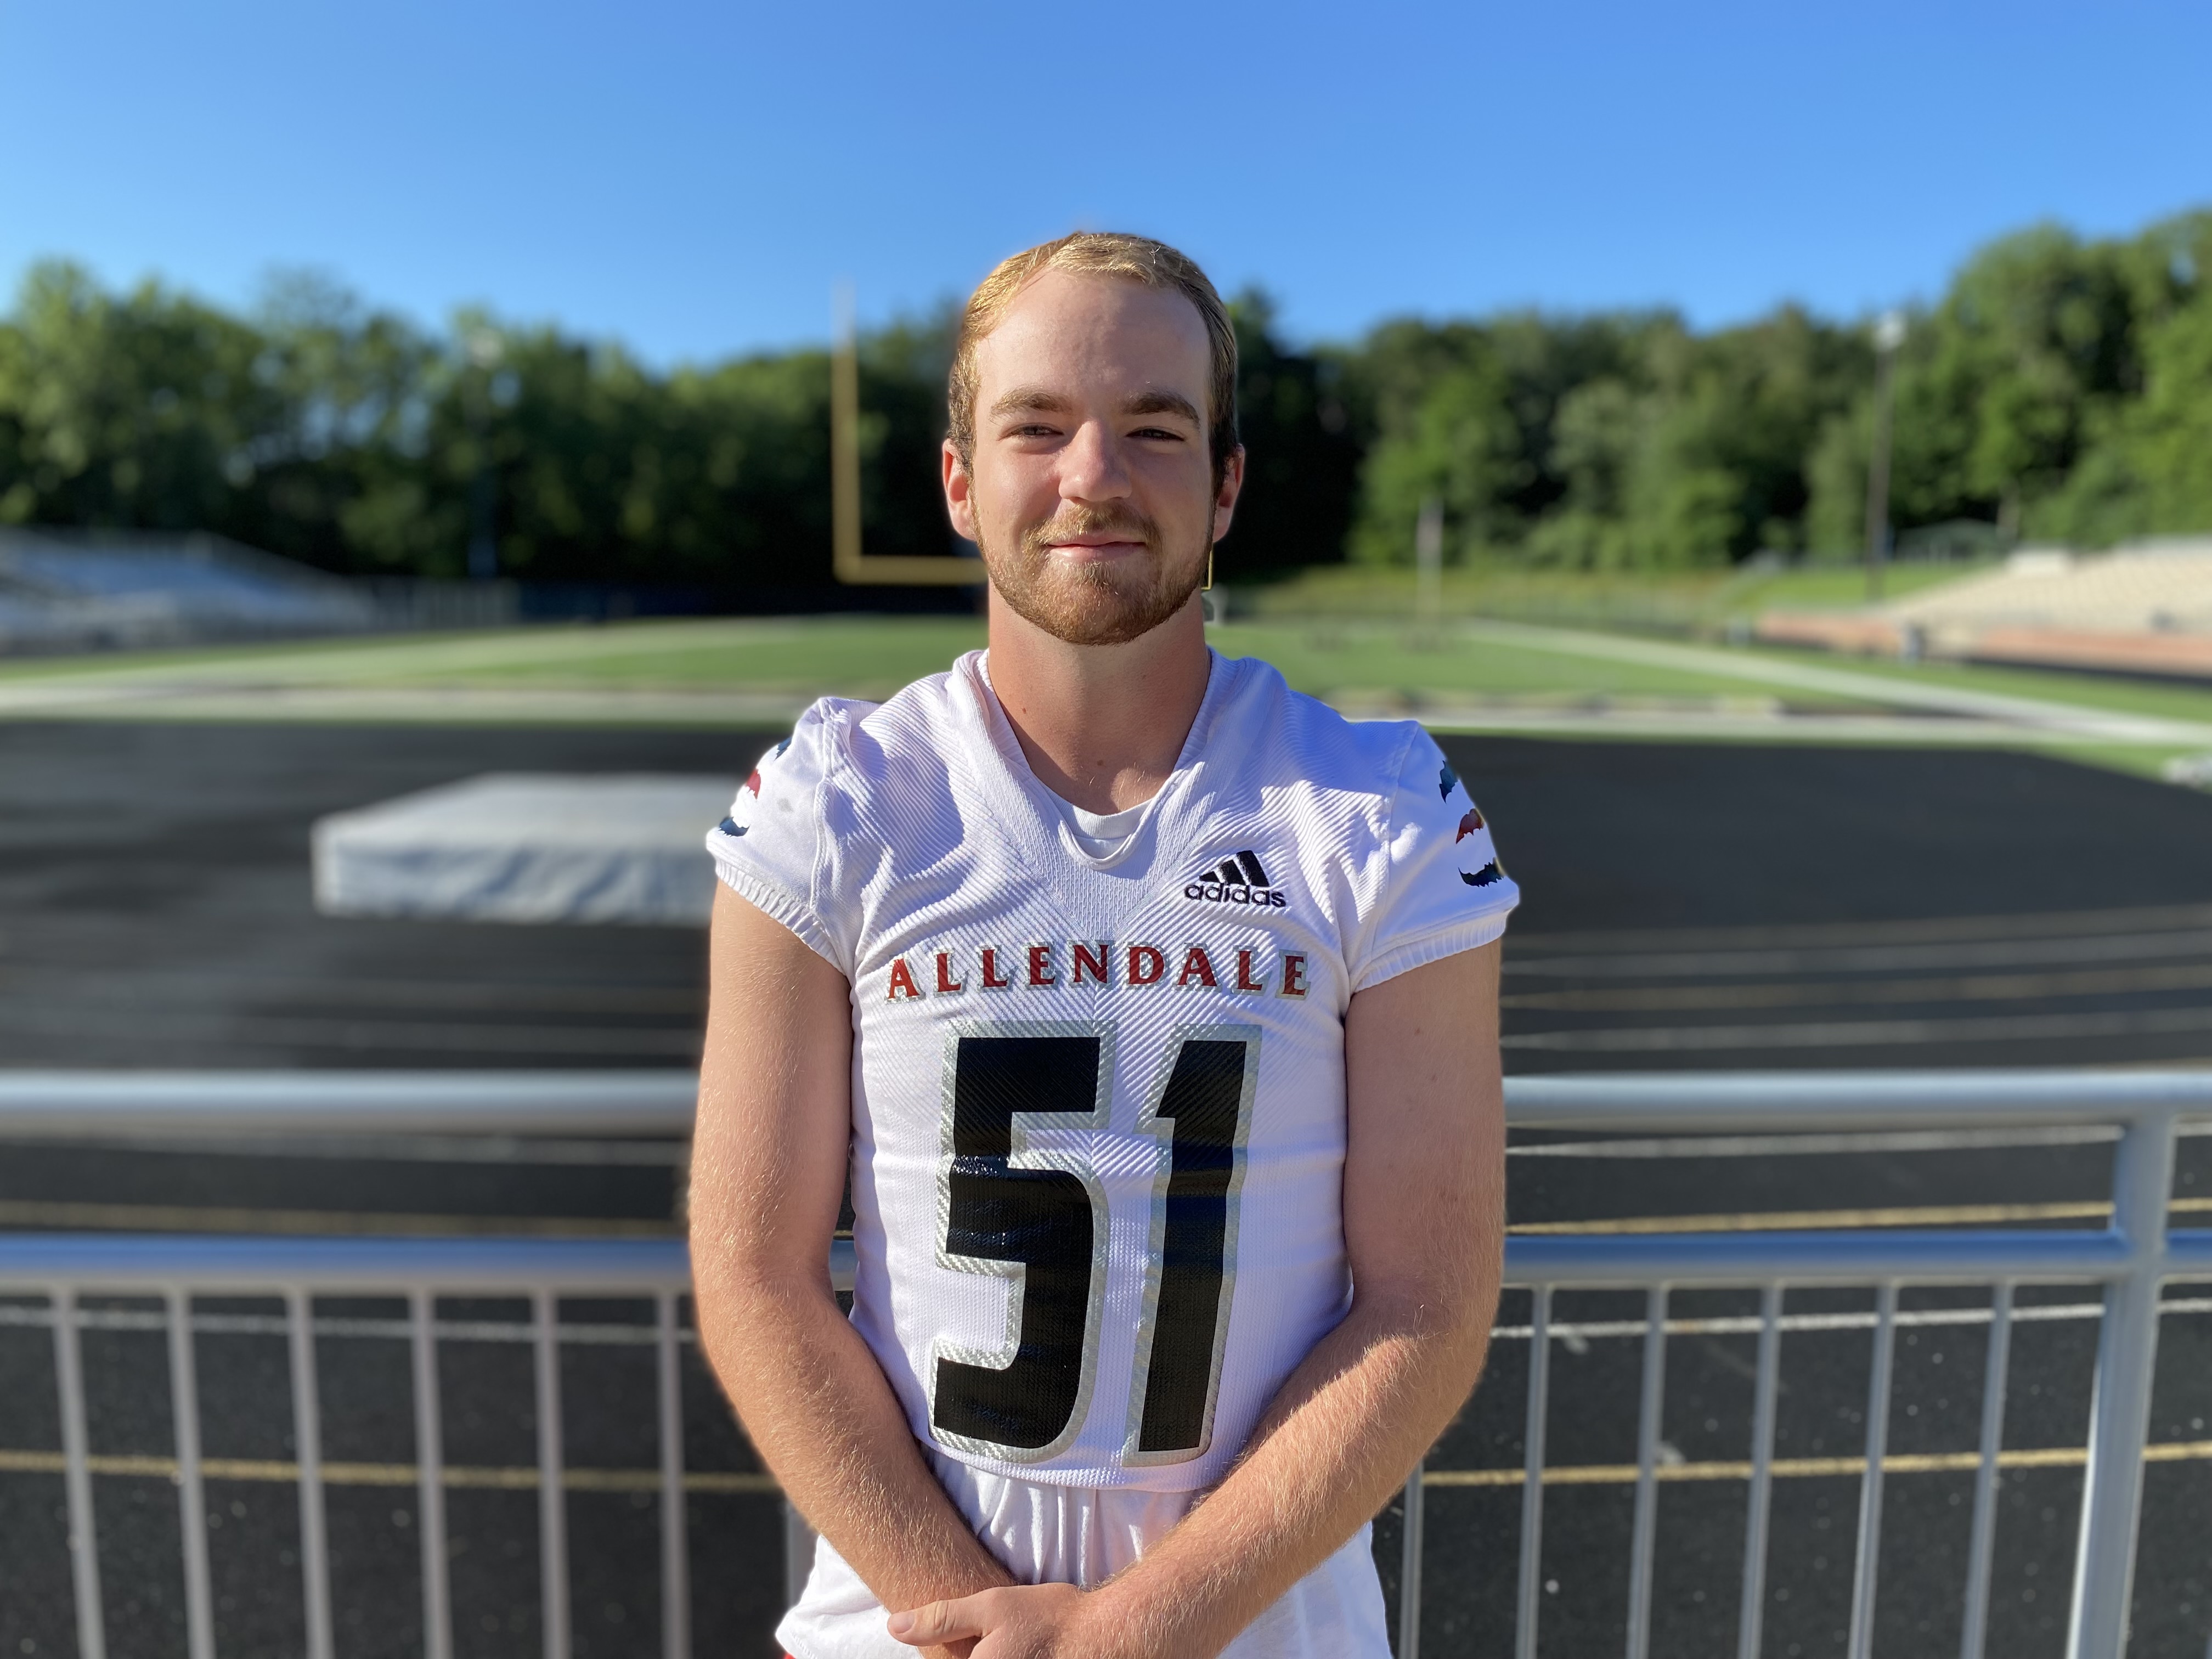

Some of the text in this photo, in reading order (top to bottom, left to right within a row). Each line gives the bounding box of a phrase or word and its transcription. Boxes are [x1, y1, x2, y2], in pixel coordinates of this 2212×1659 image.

[1185, 882, 1286, 907] adidas
[886, 942, 1311, 1002] ALLENDALE
[930, 1022, 1261, 1466] 51
